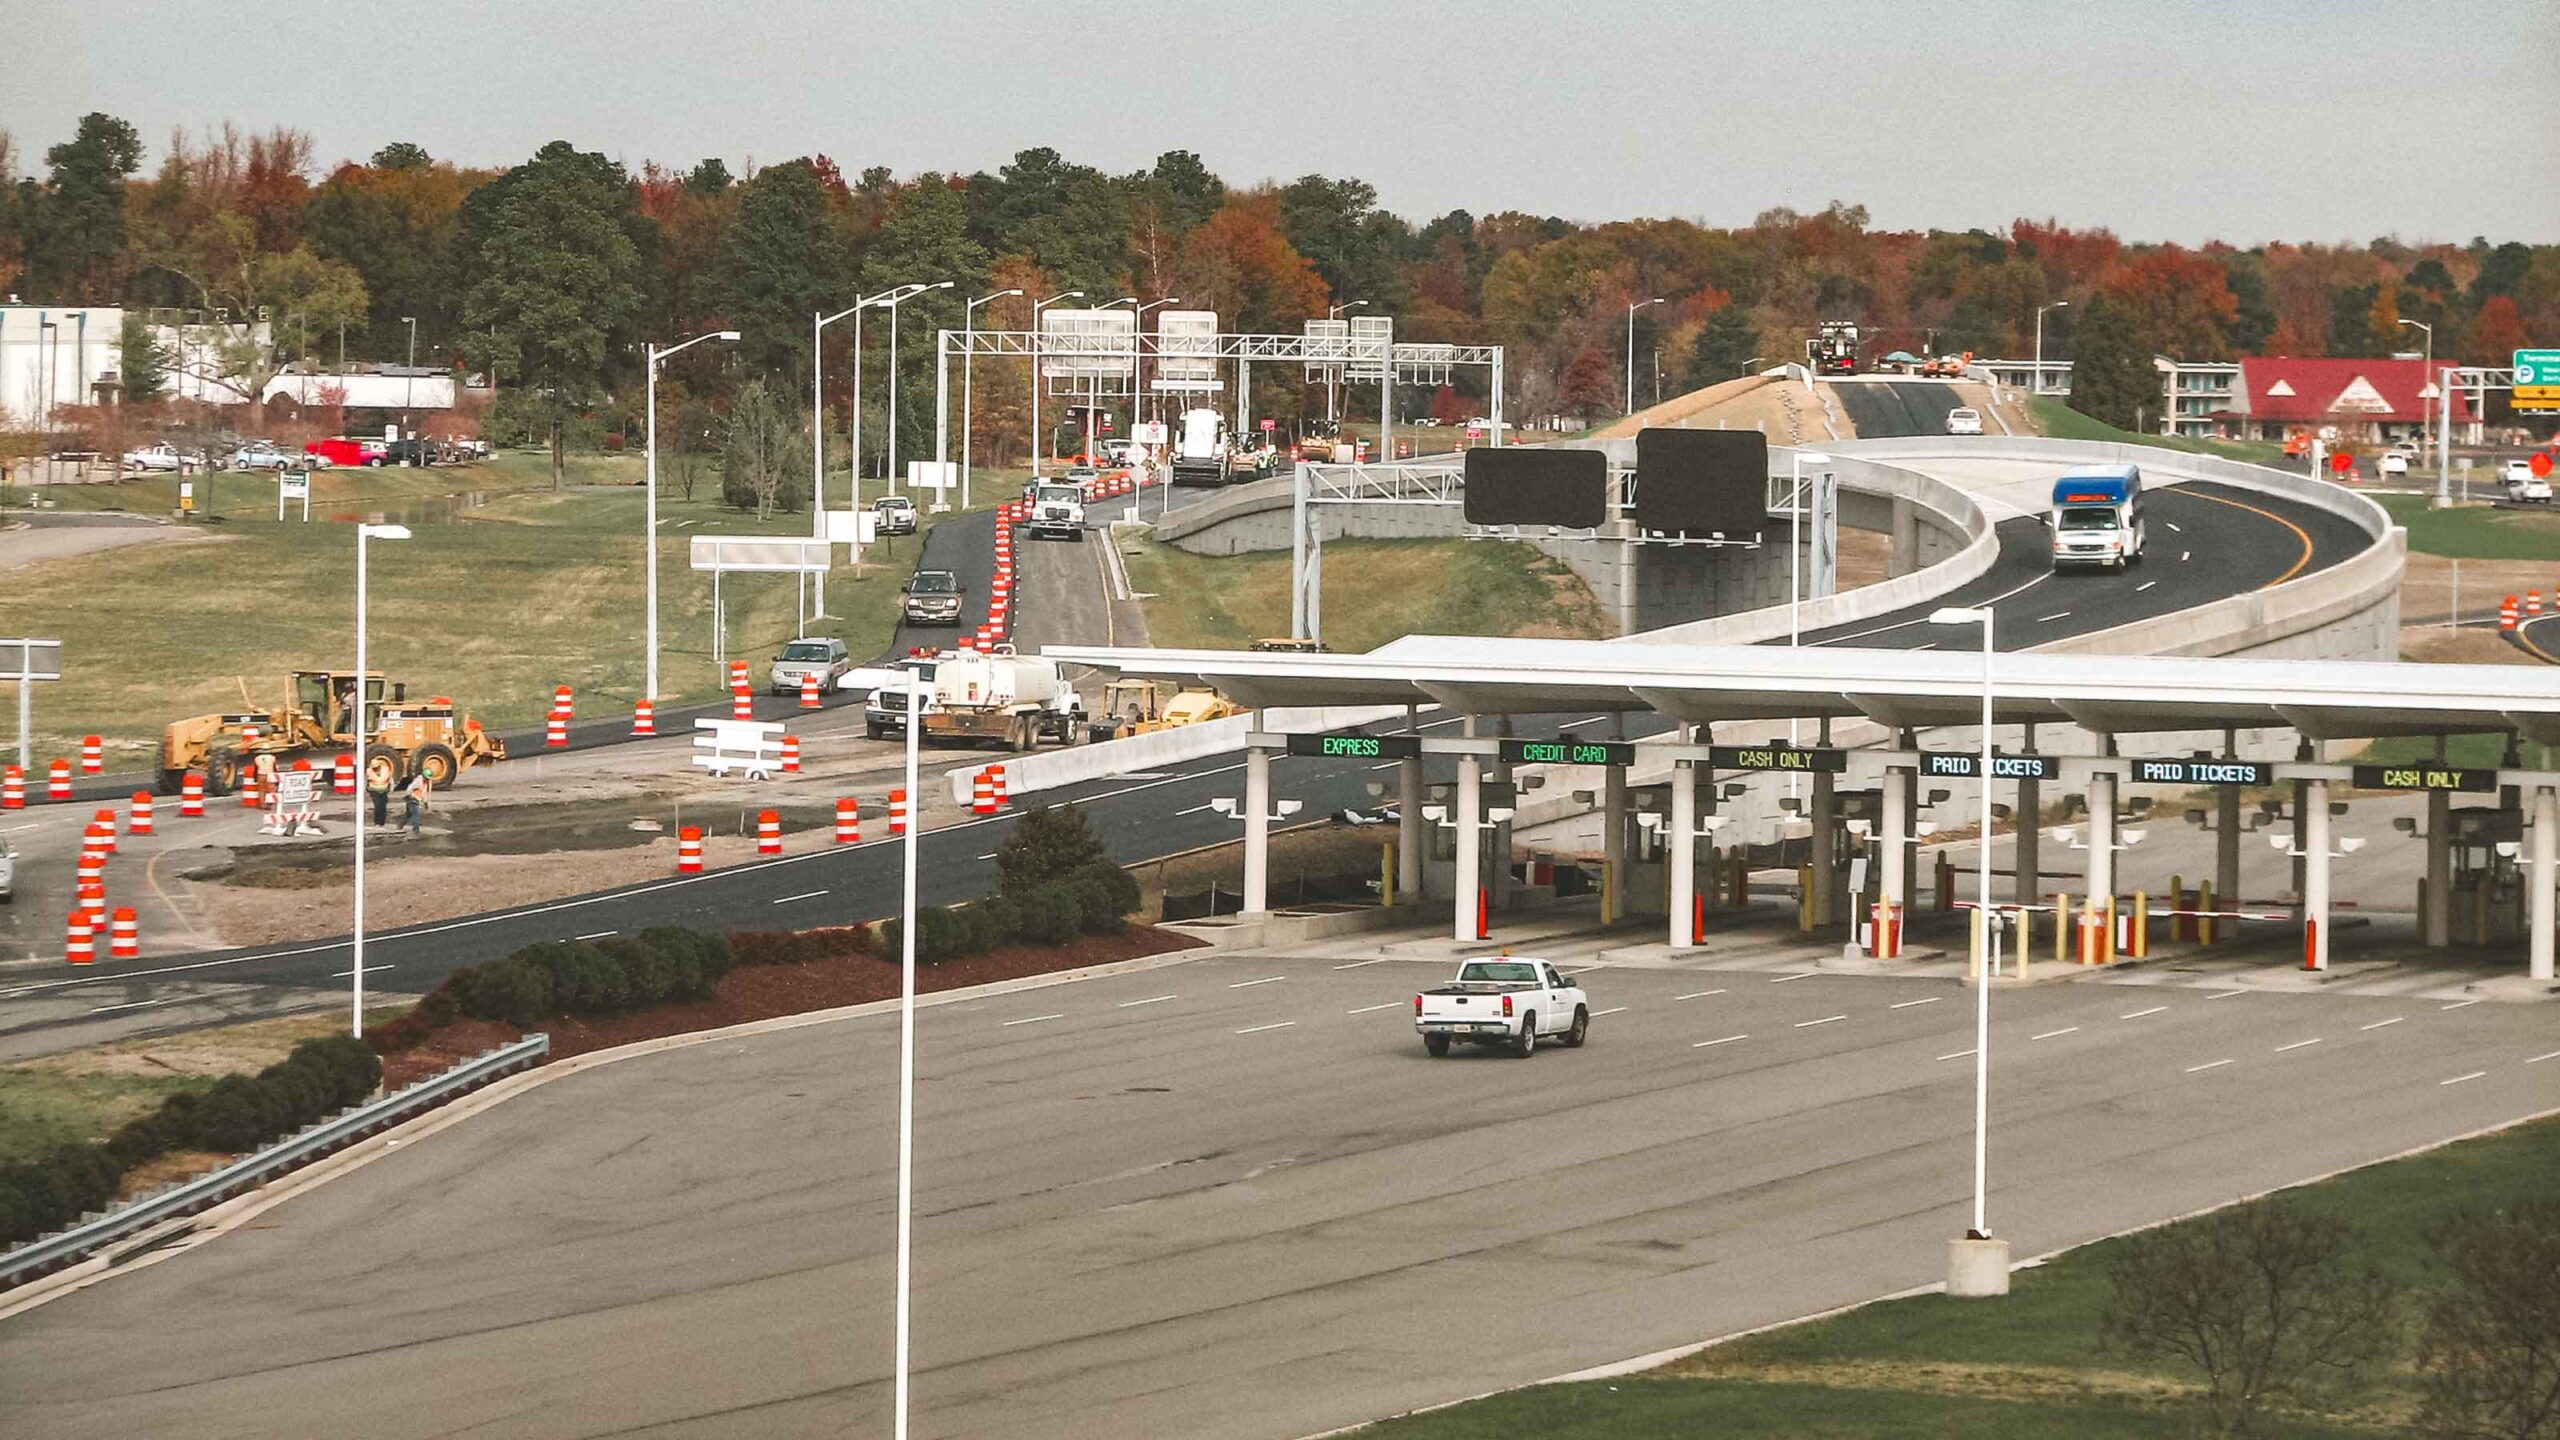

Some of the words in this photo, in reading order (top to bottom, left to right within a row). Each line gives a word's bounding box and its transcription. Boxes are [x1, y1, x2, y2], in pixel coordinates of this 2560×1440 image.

[1323, 737, 1379, 756] EXPRESS
[1523, 744, 1567, 761] CREDIT
[1573, 745, 1607, 763] CARD
[1739, 751, 1773, 767] CASH
[1780, 752, 1813, 769] ONLY
[1932, 756, 1971, 774] PAID
[2143, 763, 2183, 780] PAID
[2189, 764, 2256, 782] TICKETS
[2383, 770, 2420, 787] CASH
[2426, 771, 2462, 788] ONLY
